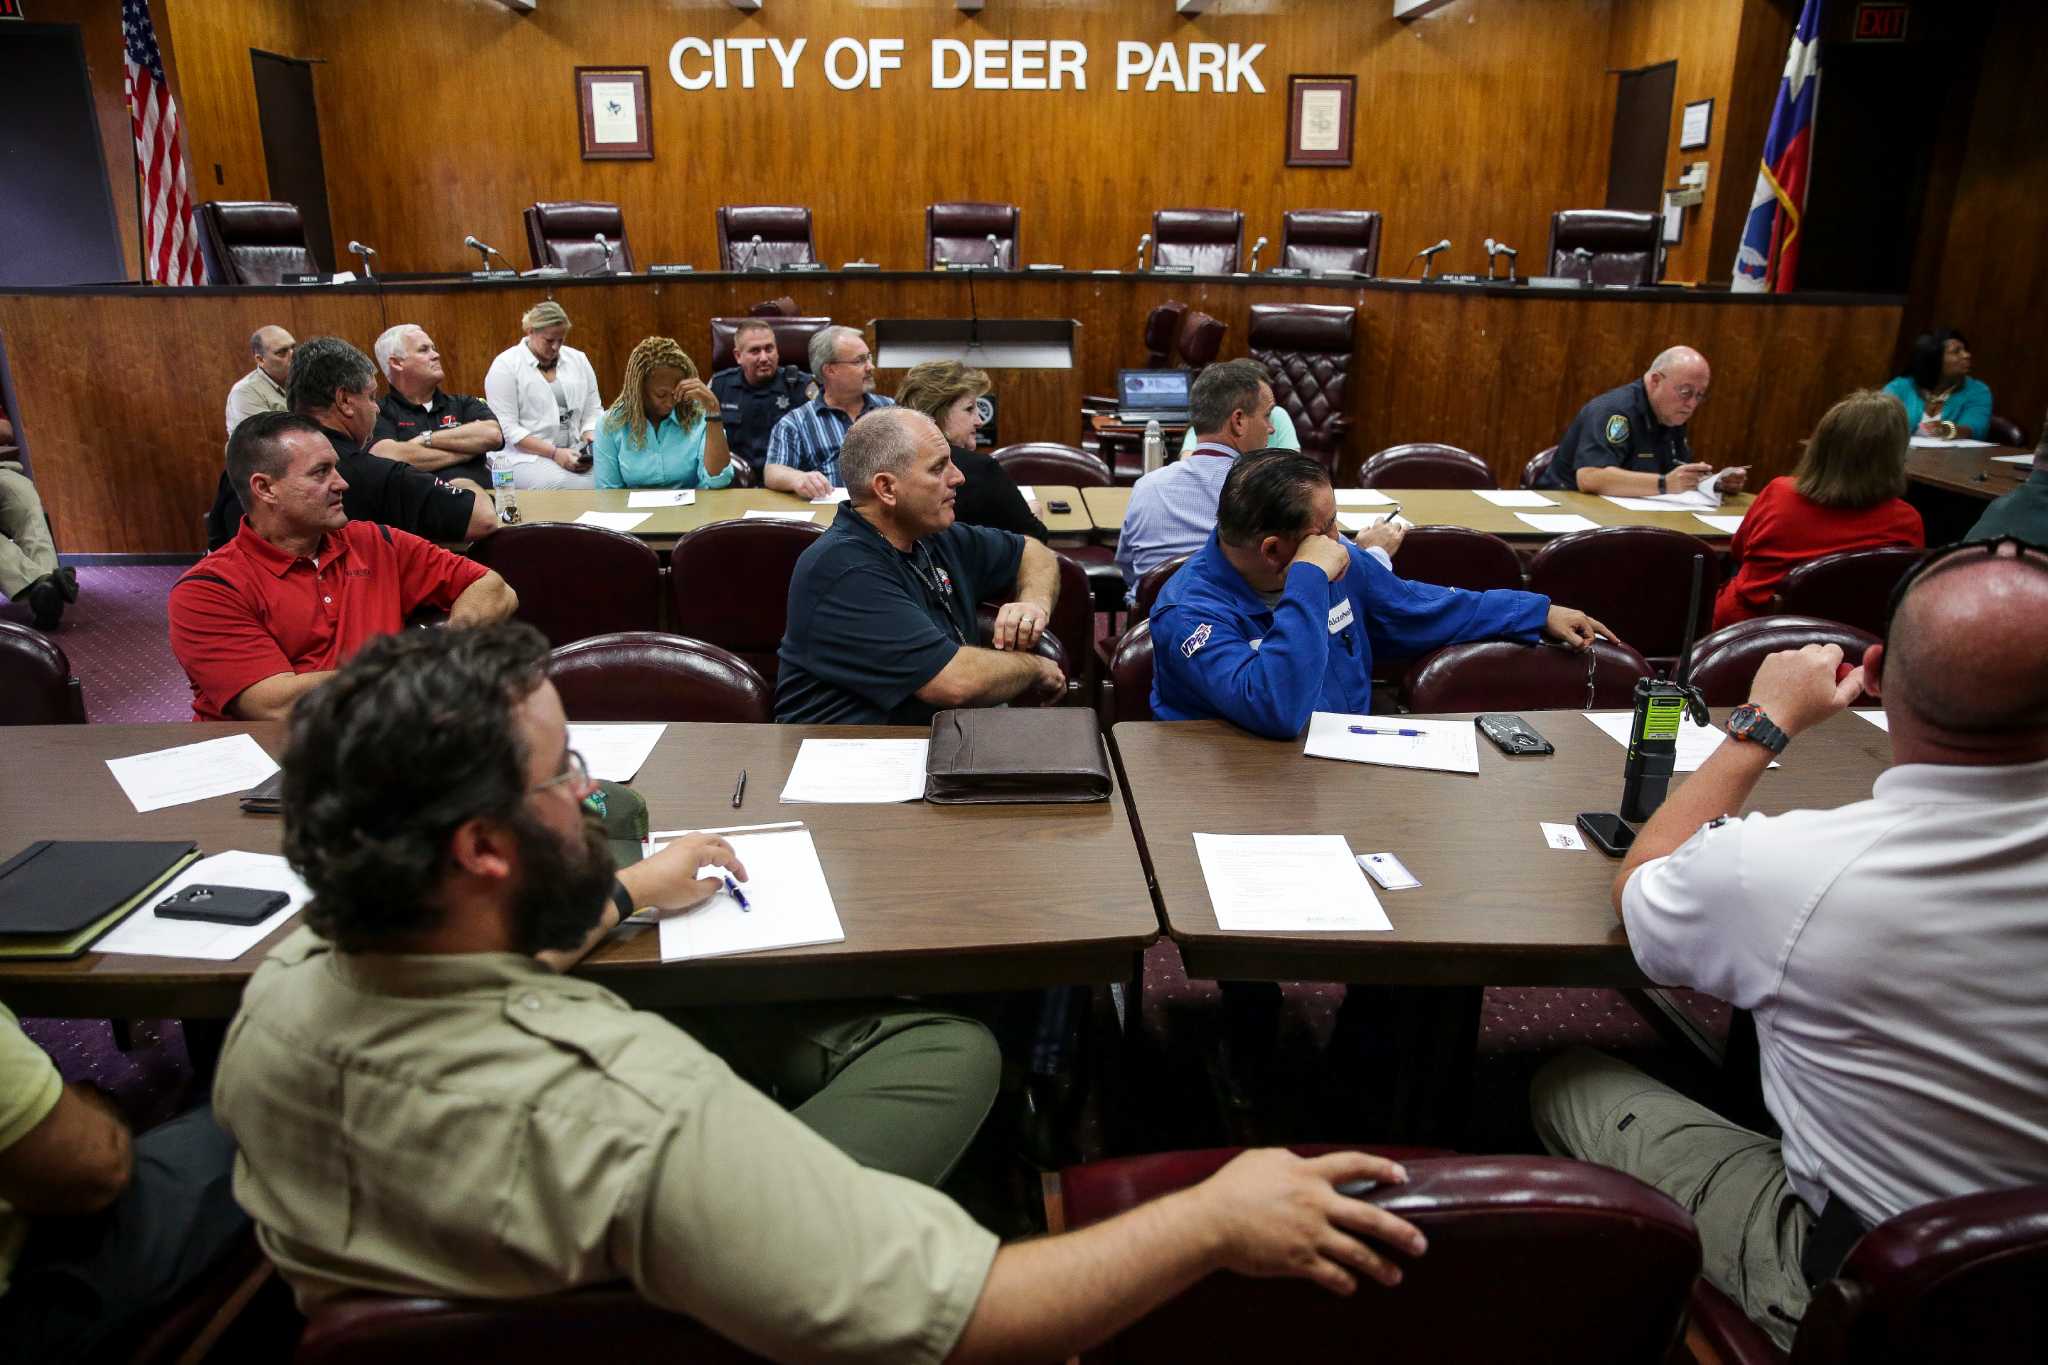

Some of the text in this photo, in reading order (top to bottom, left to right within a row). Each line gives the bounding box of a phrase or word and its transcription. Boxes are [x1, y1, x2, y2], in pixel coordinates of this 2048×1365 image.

[1860, 8, 1905, 35] EXIT
[669, 37, 1266, 93] CITY OF DEER PARK
